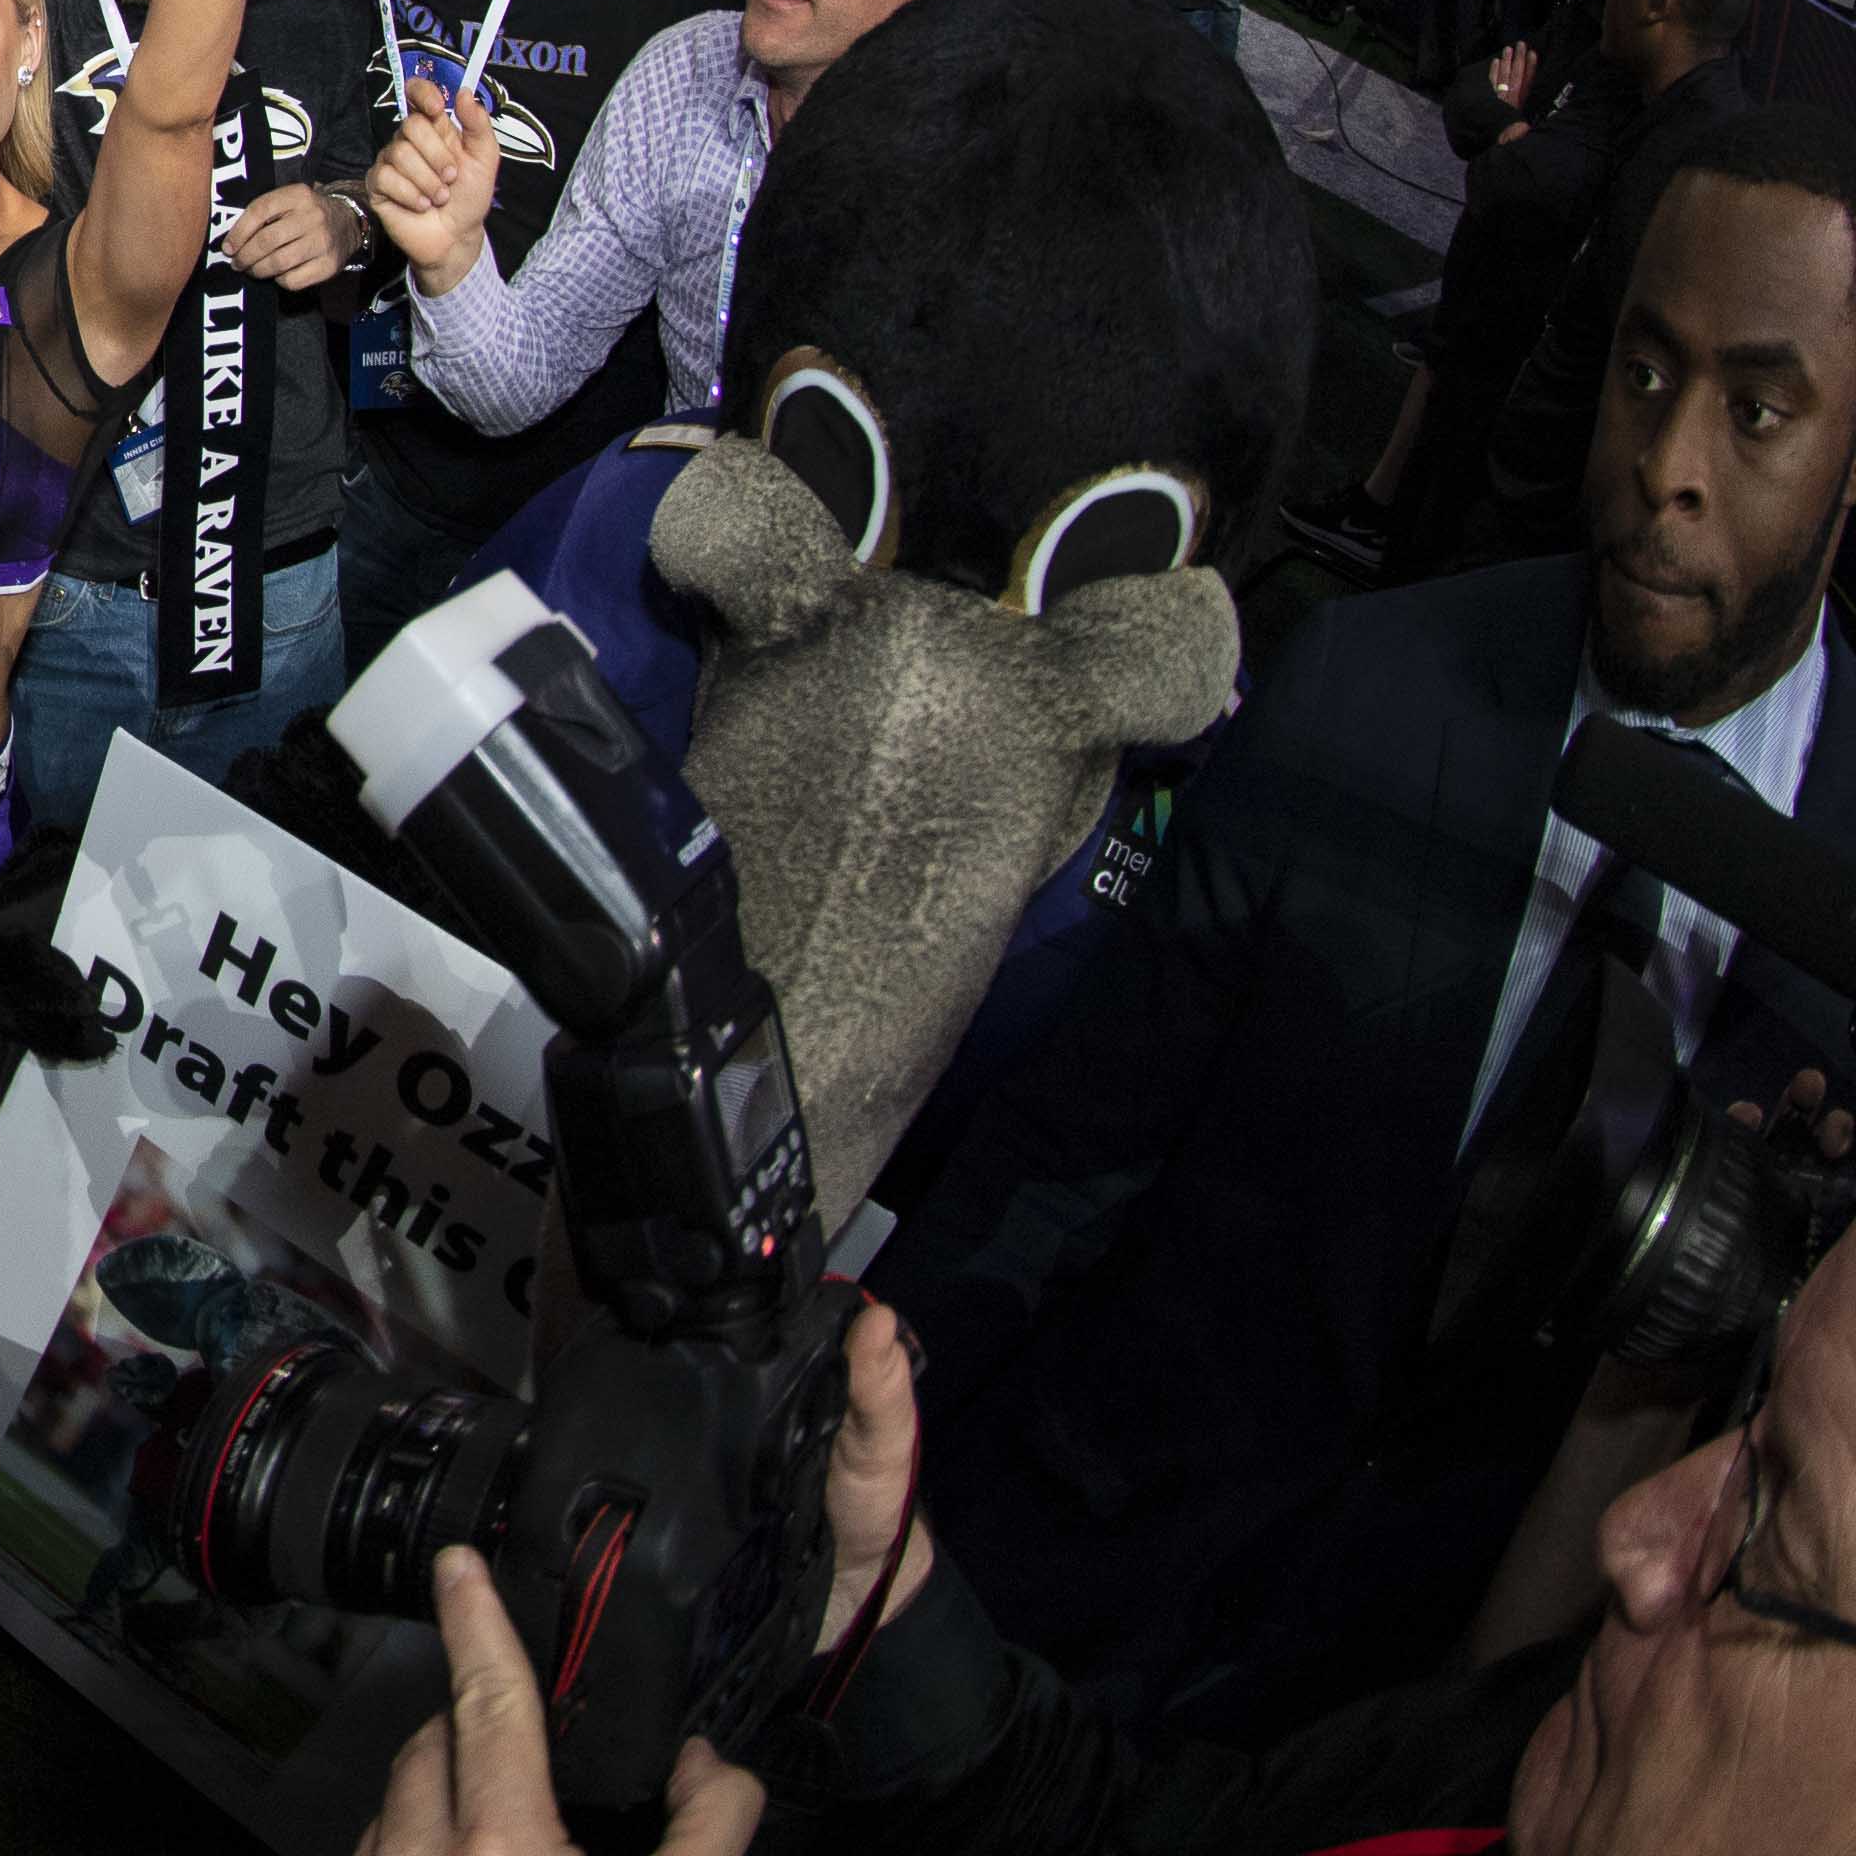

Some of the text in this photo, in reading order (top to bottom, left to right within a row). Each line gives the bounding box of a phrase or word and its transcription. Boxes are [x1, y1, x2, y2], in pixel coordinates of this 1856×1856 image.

[192, 117, 246, 675] PLAY LIKE A RAVEN
[362, 350, 398, 367] INNER
[123, 442, 149, 461] INNER
[198, 912, 382, 1076] Hey
[85, 956, 488, 1276] Draft this
